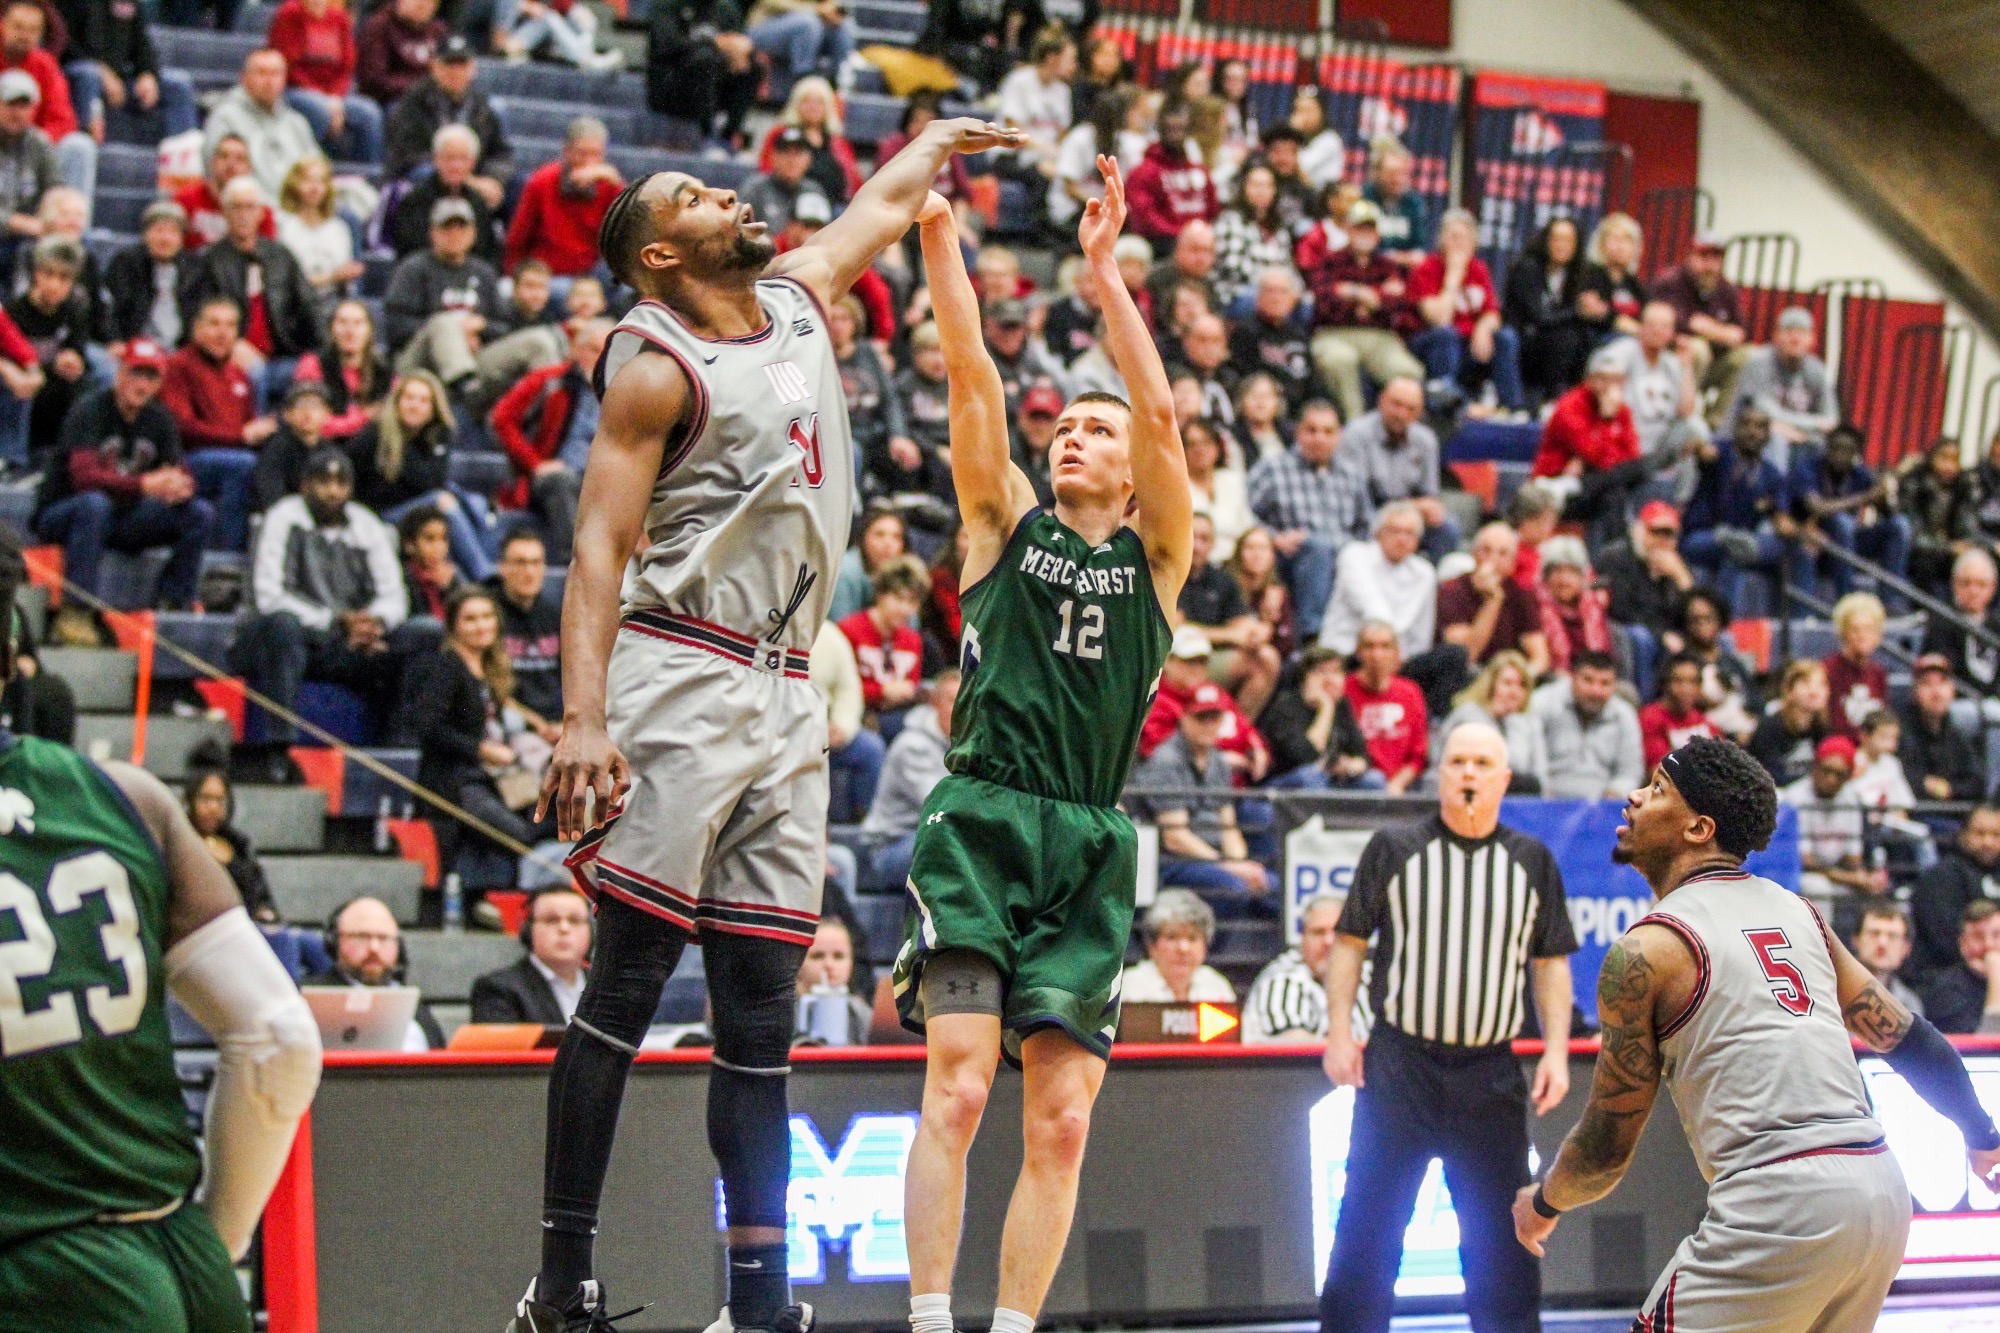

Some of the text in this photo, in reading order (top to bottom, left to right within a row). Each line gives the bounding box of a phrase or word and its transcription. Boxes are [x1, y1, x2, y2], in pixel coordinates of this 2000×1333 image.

[1052, 599, 1105, 660] 12
[0, 850, 148, 1057] 23
[1741, 927, 1815, 1017] 5
